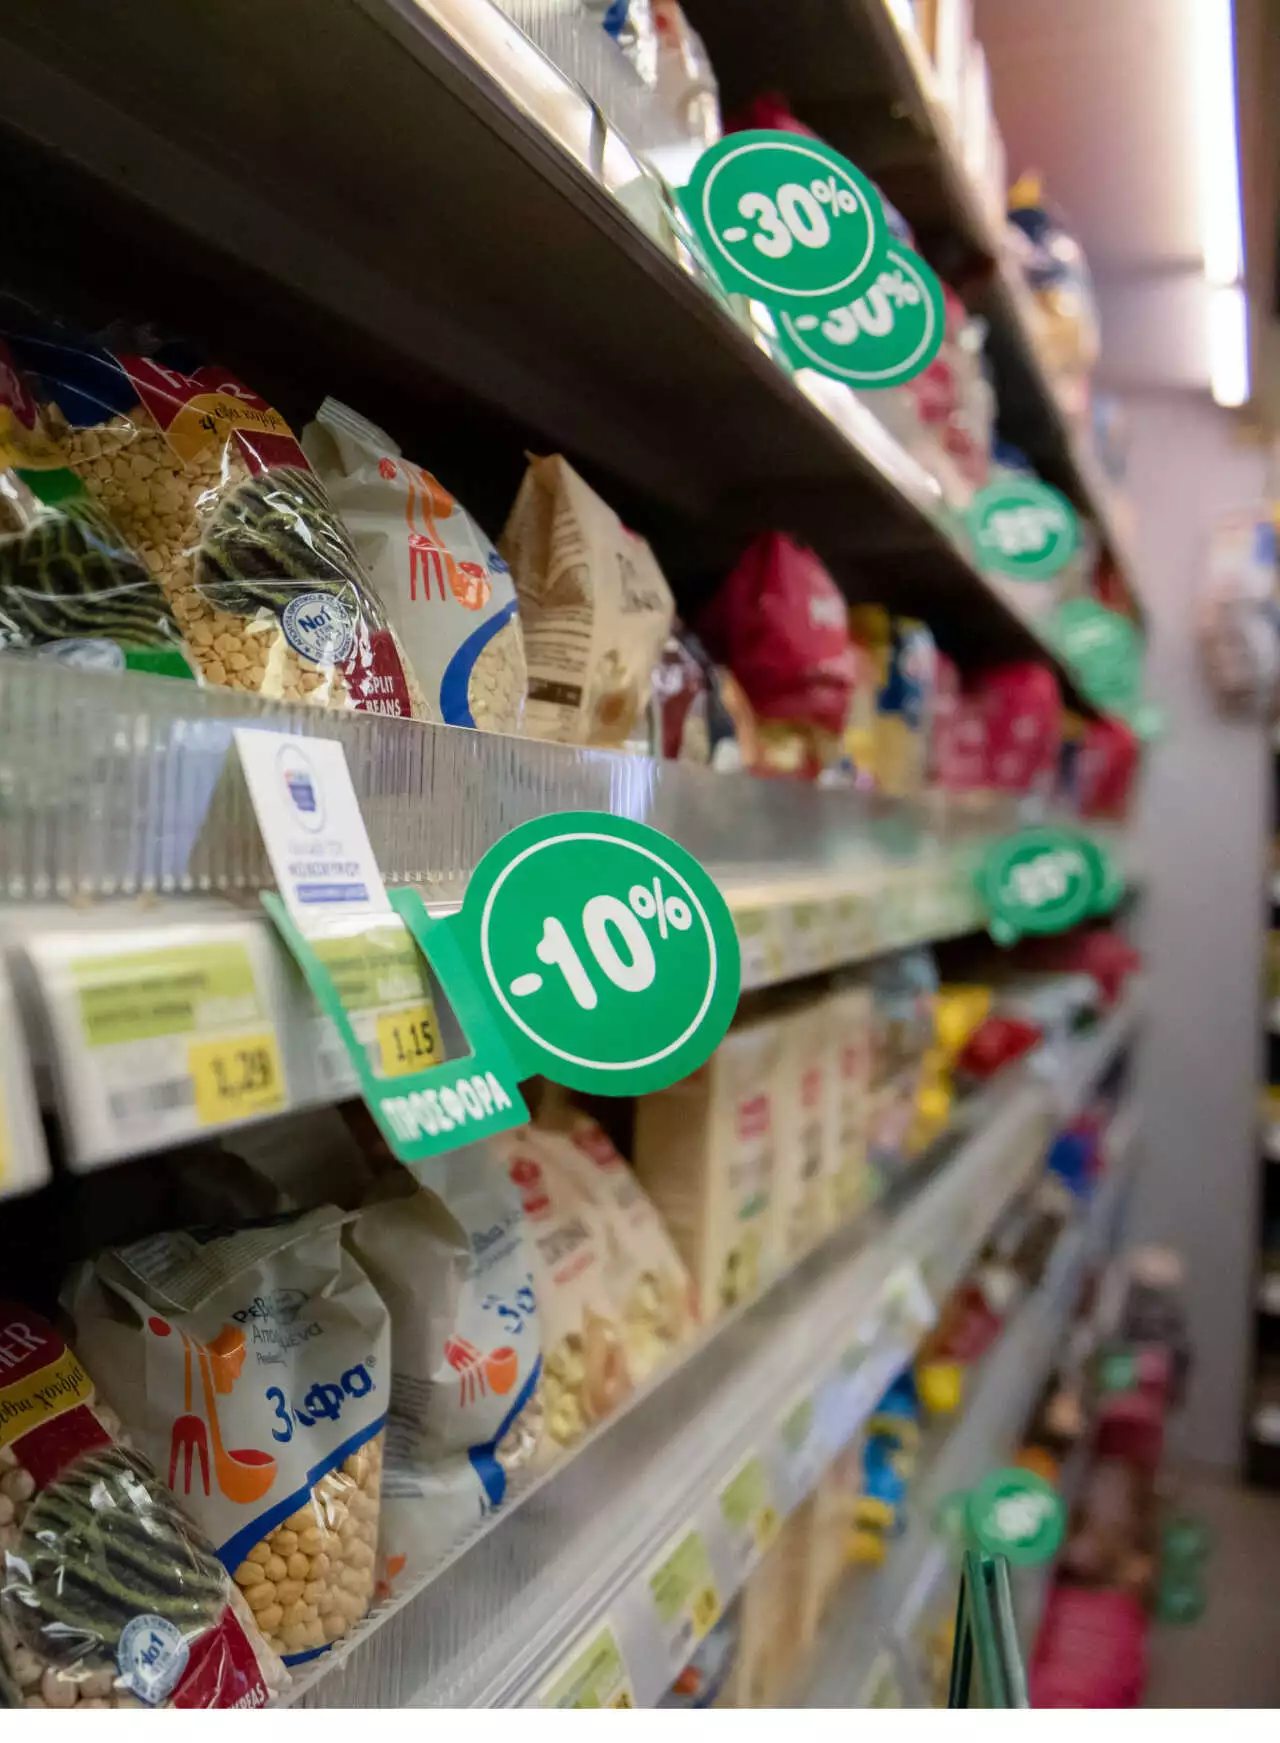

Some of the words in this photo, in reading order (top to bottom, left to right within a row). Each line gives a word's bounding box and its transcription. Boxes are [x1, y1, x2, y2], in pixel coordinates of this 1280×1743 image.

[722, 176, 858, 258] -30%
[366, 698, 401, 717] BEANS
[368, 676, 394, 694] SPLIT
[510, 877, 693, 1010] -10%
